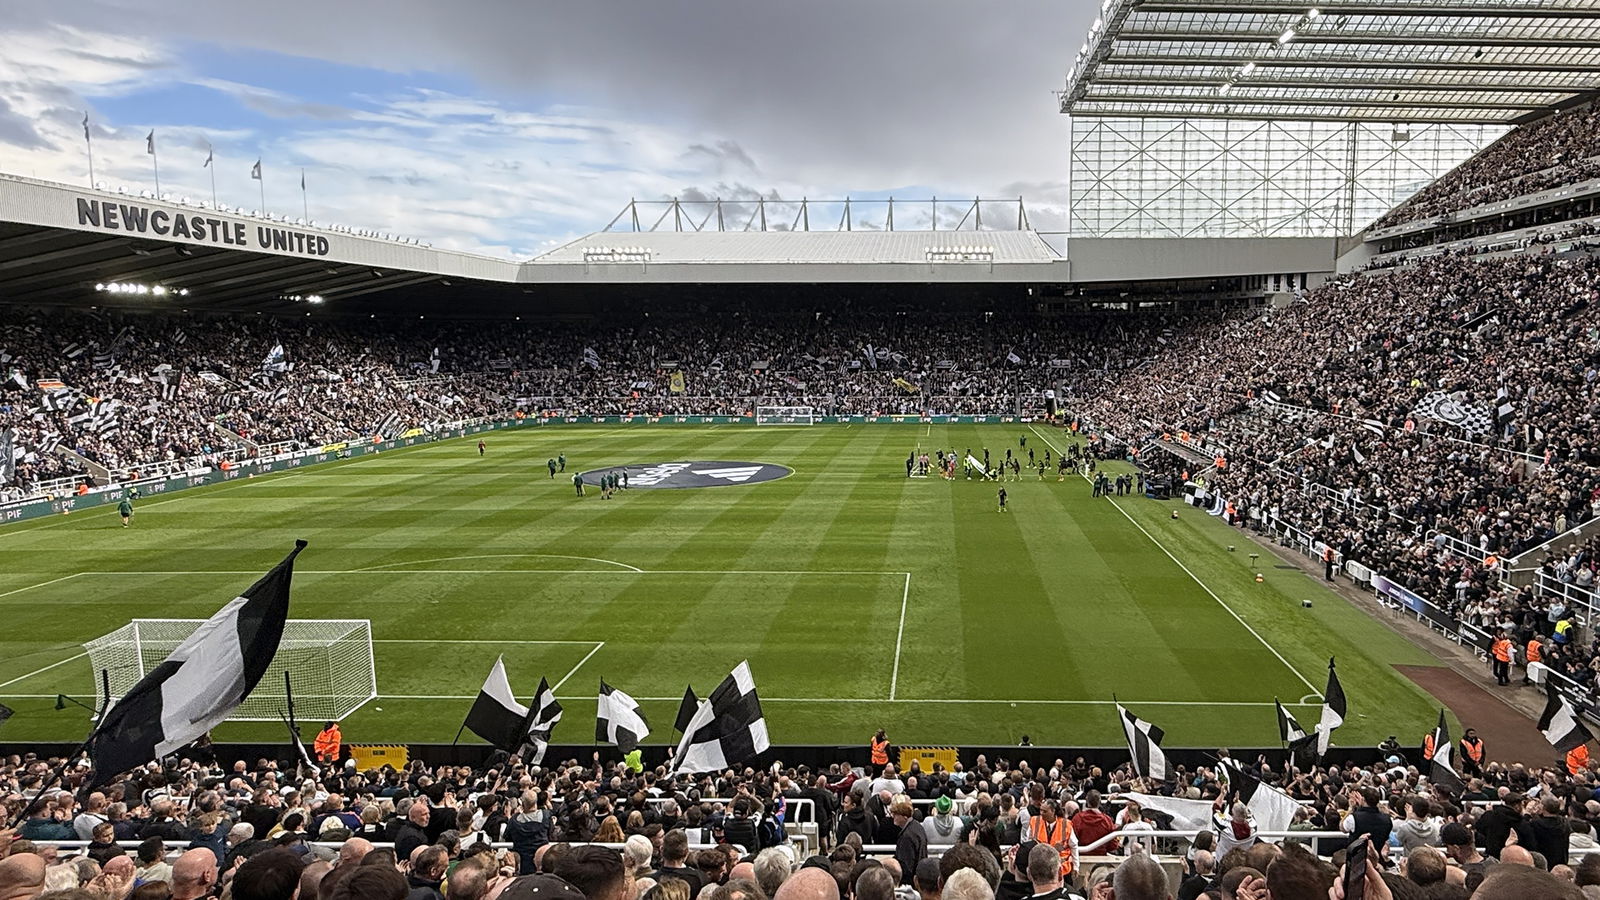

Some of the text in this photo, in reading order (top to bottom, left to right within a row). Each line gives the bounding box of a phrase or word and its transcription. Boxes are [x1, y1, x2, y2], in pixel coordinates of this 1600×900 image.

[77, 197, 330, 256] NEWCASTLE UNITED
[229, 470, 239, 479] PIF
[194, 477, 204, 486] PIF
[154, 483, 166, 493] PIF
[110, 491, 123, 501] PIF
[61, 500, 76, 510] PIF
[6, 509, 23, 520] PIF
